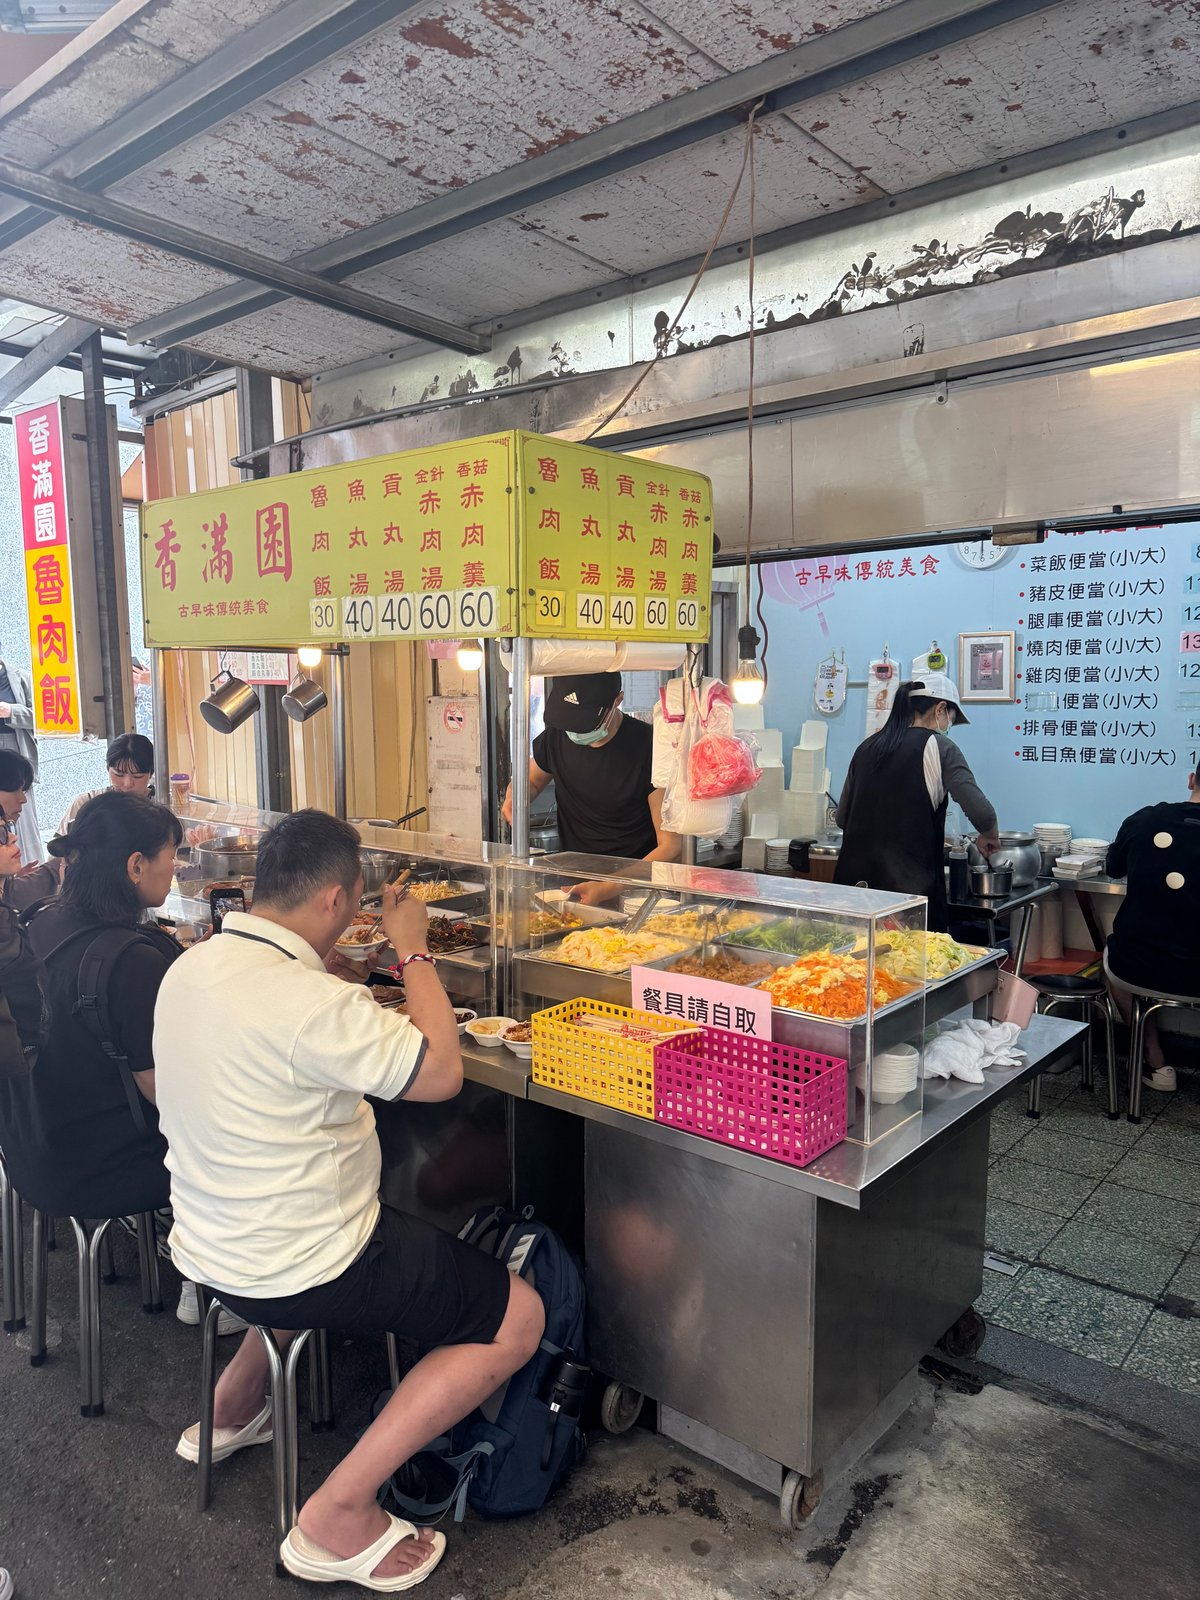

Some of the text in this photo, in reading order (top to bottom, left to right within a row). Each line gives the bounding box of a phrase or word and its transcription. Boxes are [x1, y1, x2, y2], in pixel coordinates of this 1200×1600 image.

[28, 415, 57, 543] 香滿園
[382, 473, 405, 593] 貢丸湯
[538, 457, 561, 580] 魯肉飯
[580, 466, 602, 586] 魚丸湯
[616, 474, 636, 589] 貢丸湯
[154, 501, 293, 593] 香滿園
[310, 484, 333, 597] 魯肉飯
[348, 479, 370, 595] 魚丸湯
[795, 553, 940, 586] 古早味傳統美食
[1030, 546, 1167, 573] 菜飯便當(小/大)
[540, 595, 561, 617] 30
[1029, 578, 1165, 602] 豬皮便當(小/大)
[178, 599, 270, 618] 古早味傳統美食
[314, 605, 335, 629] 30
[345, 599, 374, 633] 40
[381, 597, 412, 631] 40
[419, 594, 452, 630] 60
[460, 591, 493, 628] 60
[579, 599, 603, 625] 40
[612, 600, 634, 625] 40
[647, 600, 667, 625] 60
[678, 602, 697, 626] 60
[33, 554, 74, 726] 魯肉飯
[1026, 636, 1162, 657] 燒肉便當(小/大)
[1025, 664, 1160, 684] 雞肉便當(小/大)
[1025, 692, 1158, 710] 便當(小/大)
[1022, 719, 1156, 738] 排骨便當(小/大)
[1022, 746, 1177, 767] 虱目魚便當(小/大)
[642, 987, 757, 1036] 餐具請自取
